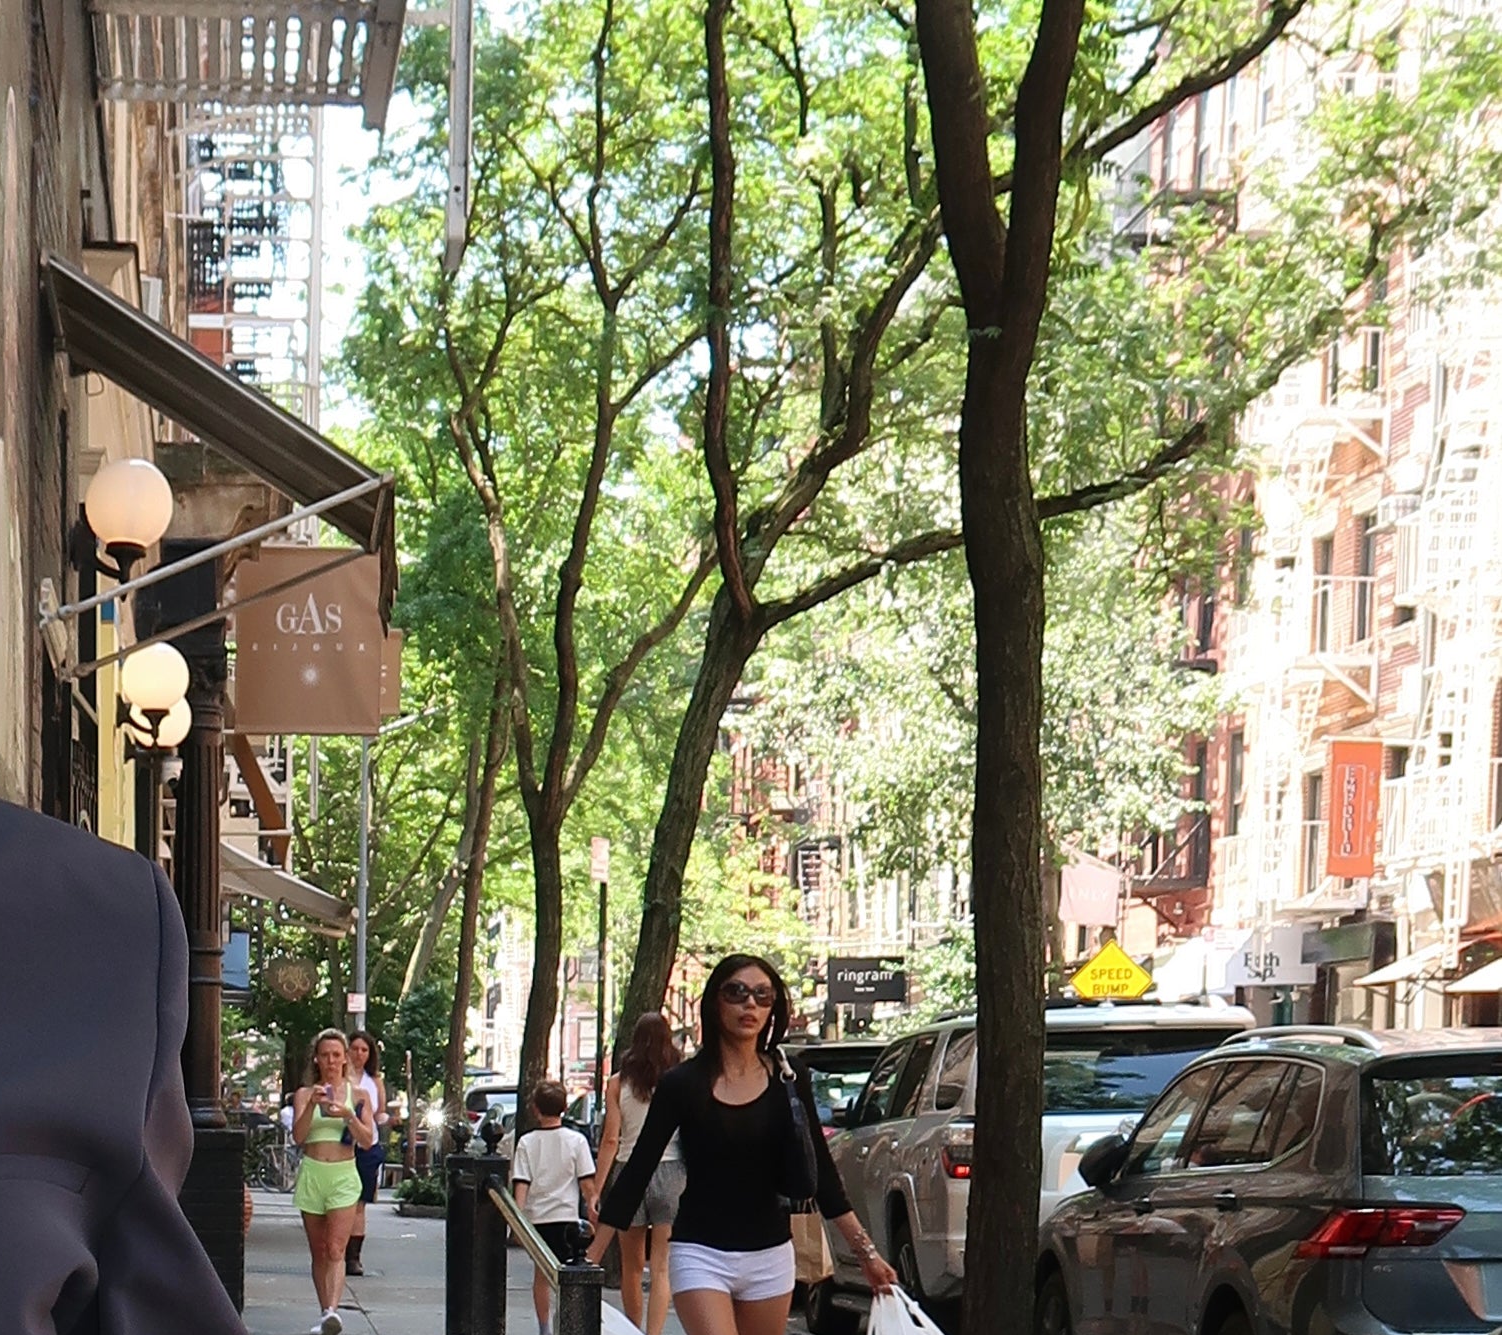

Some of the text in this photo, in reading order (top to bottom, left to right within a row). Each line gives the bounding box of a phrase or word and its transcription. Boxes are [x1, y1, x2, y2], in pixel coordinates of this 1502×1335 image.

[275, 592, 342, 635] GAS
[1090, 968, 1133, 981] SPEED
[1092, 983, 1129, 996] BUMP
